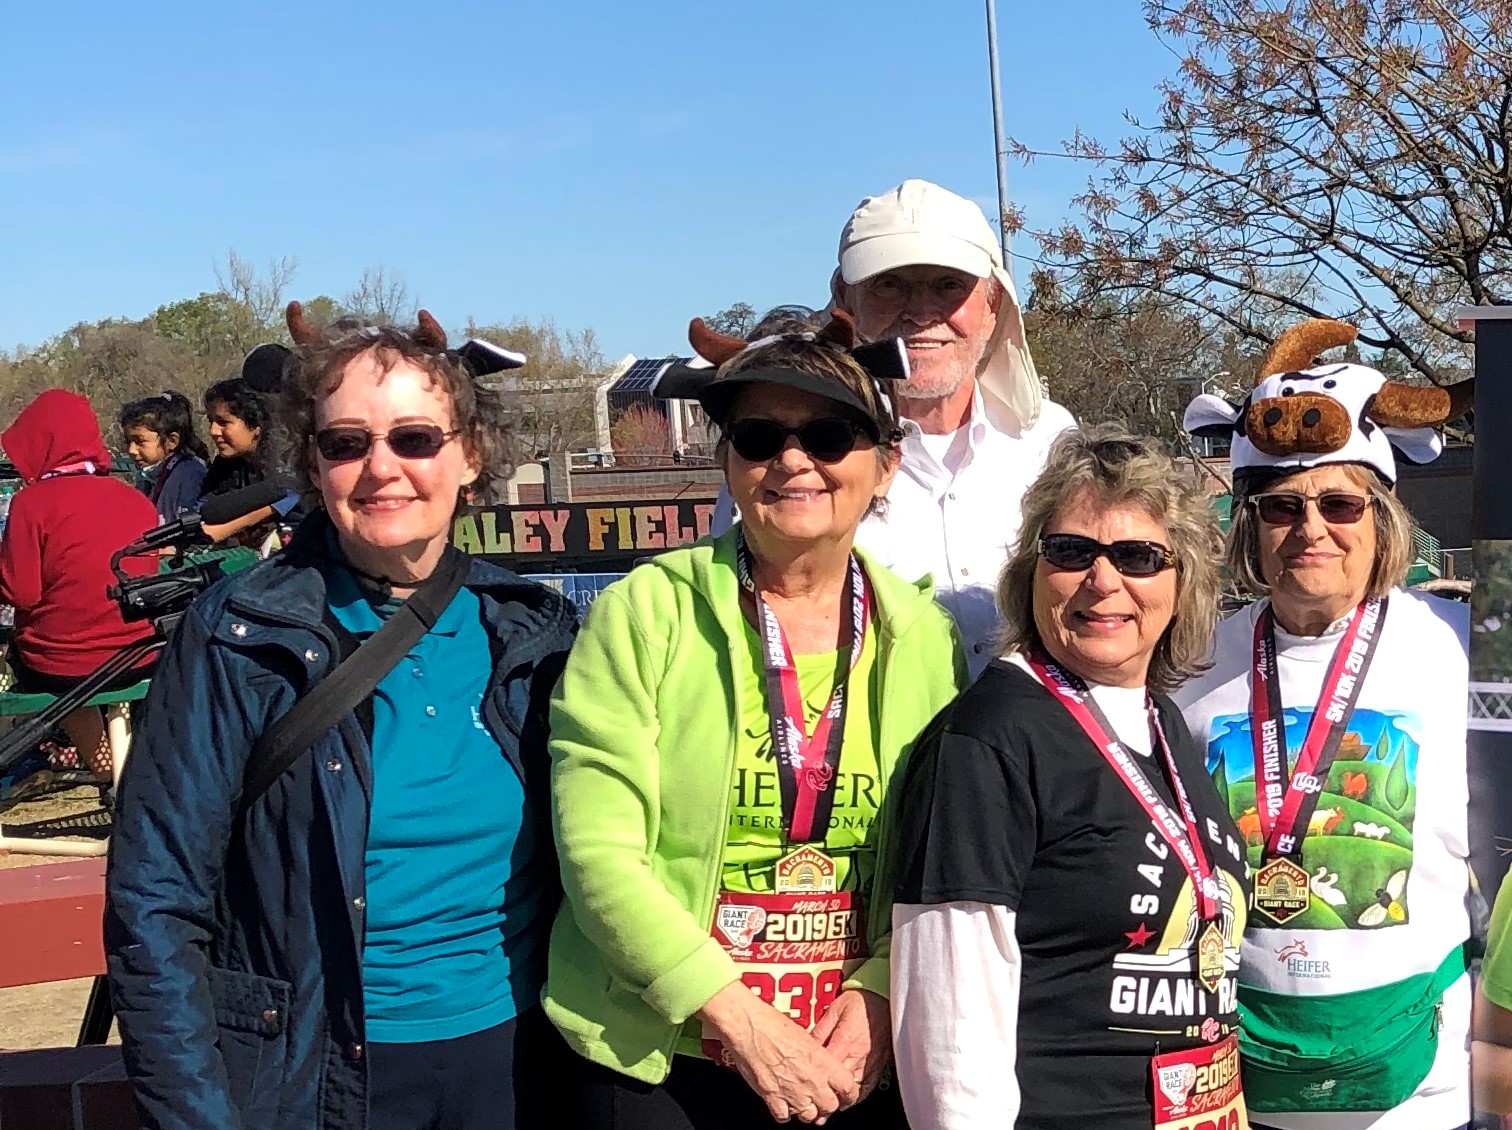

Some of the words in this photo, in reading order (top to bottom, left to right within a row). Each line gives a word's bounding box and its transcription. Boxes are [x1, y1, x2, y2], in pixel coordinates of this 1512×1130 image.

[453, 509, 570, 554] ALEY
[1261, 718, 1281, 782] FINISHER
[734, 768, 878, 809] HEER
[782, 852, 831, 876] SACRAMENTO
[722, 909, 748, 920] GIANT
[723, 919, 746, 929] RACE
[766, 913, 827, 942] 2019
[756, 939, 860, 962] SACRAMENTO
[1287, 958, 1331, 973] HEIFER
